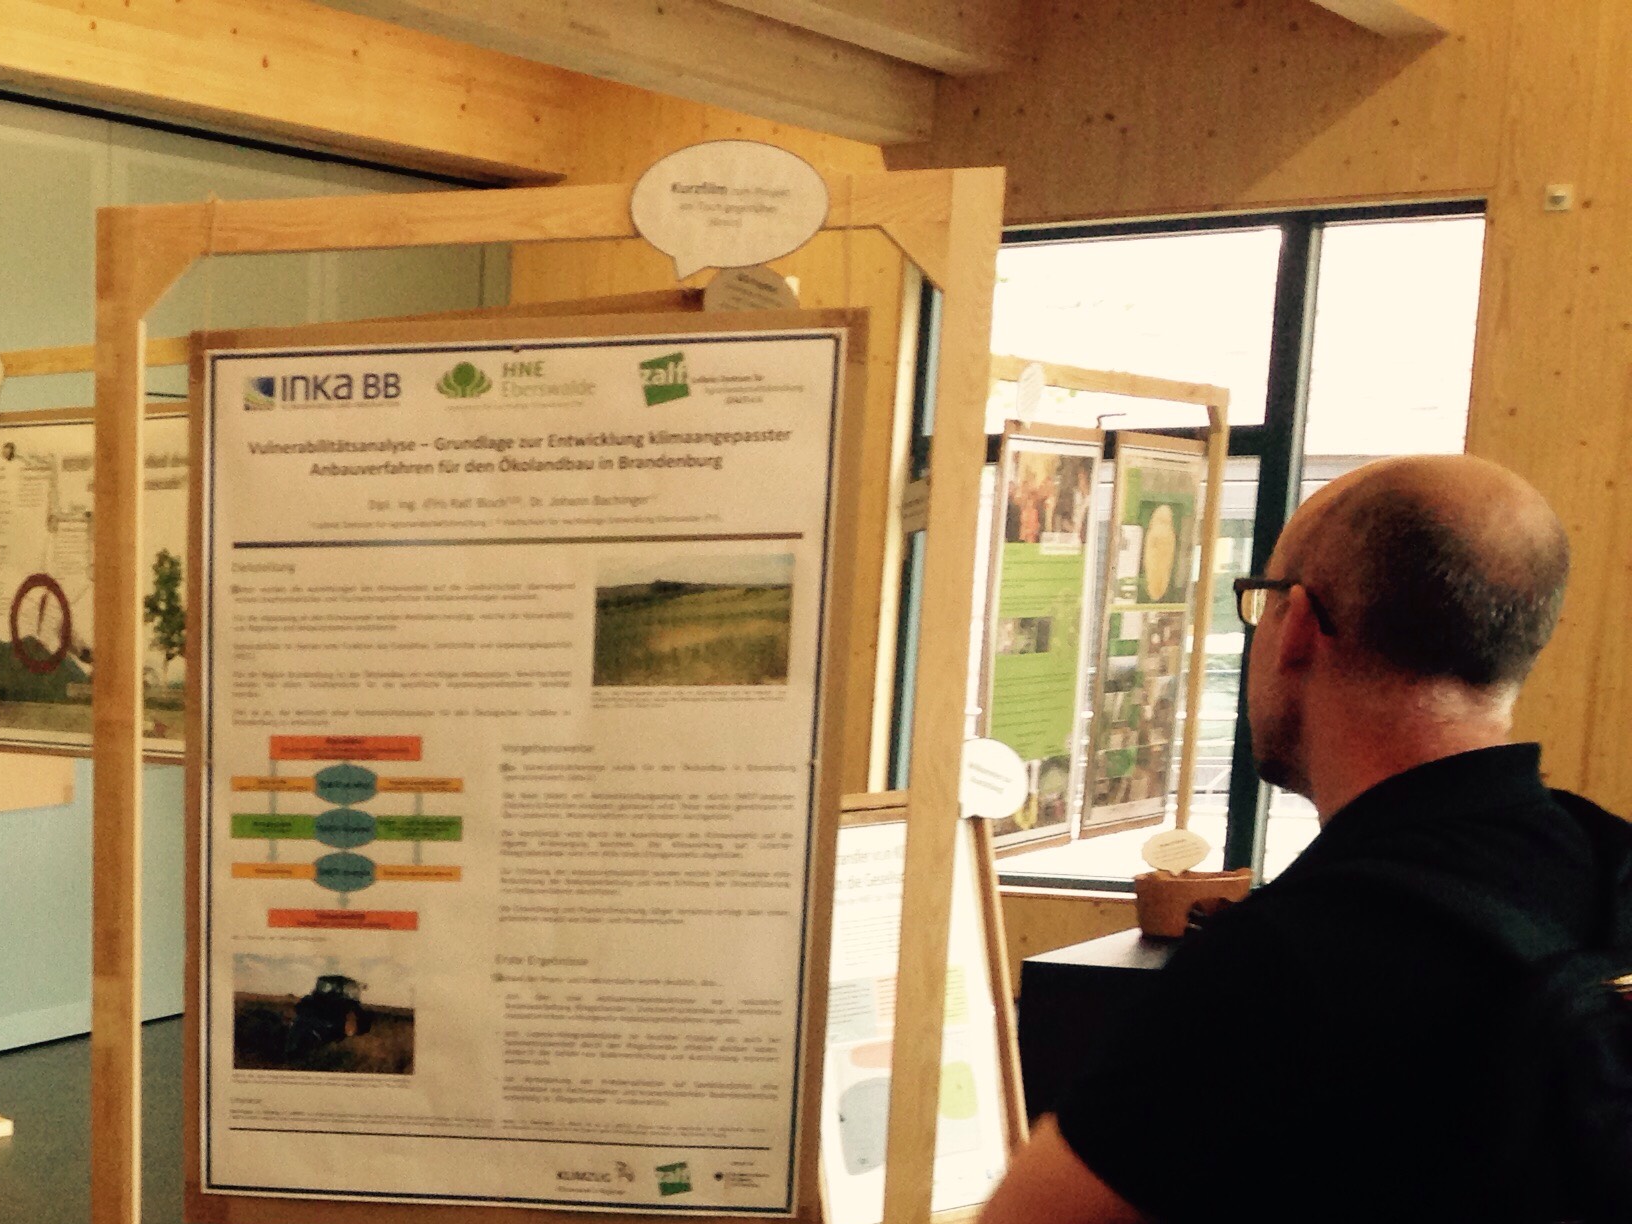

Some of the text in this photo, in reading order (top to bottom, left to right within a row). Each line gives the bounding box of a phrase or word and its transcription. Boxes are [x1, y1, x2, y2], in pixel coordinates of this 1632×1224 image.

[502, 360, 544, 378] HNE
[362, 372, 402, 400] BB
[438, 459, 460, 474] für
[464, 459, 495, 473] den
[617, 455, 724, 471] Brandenburg
